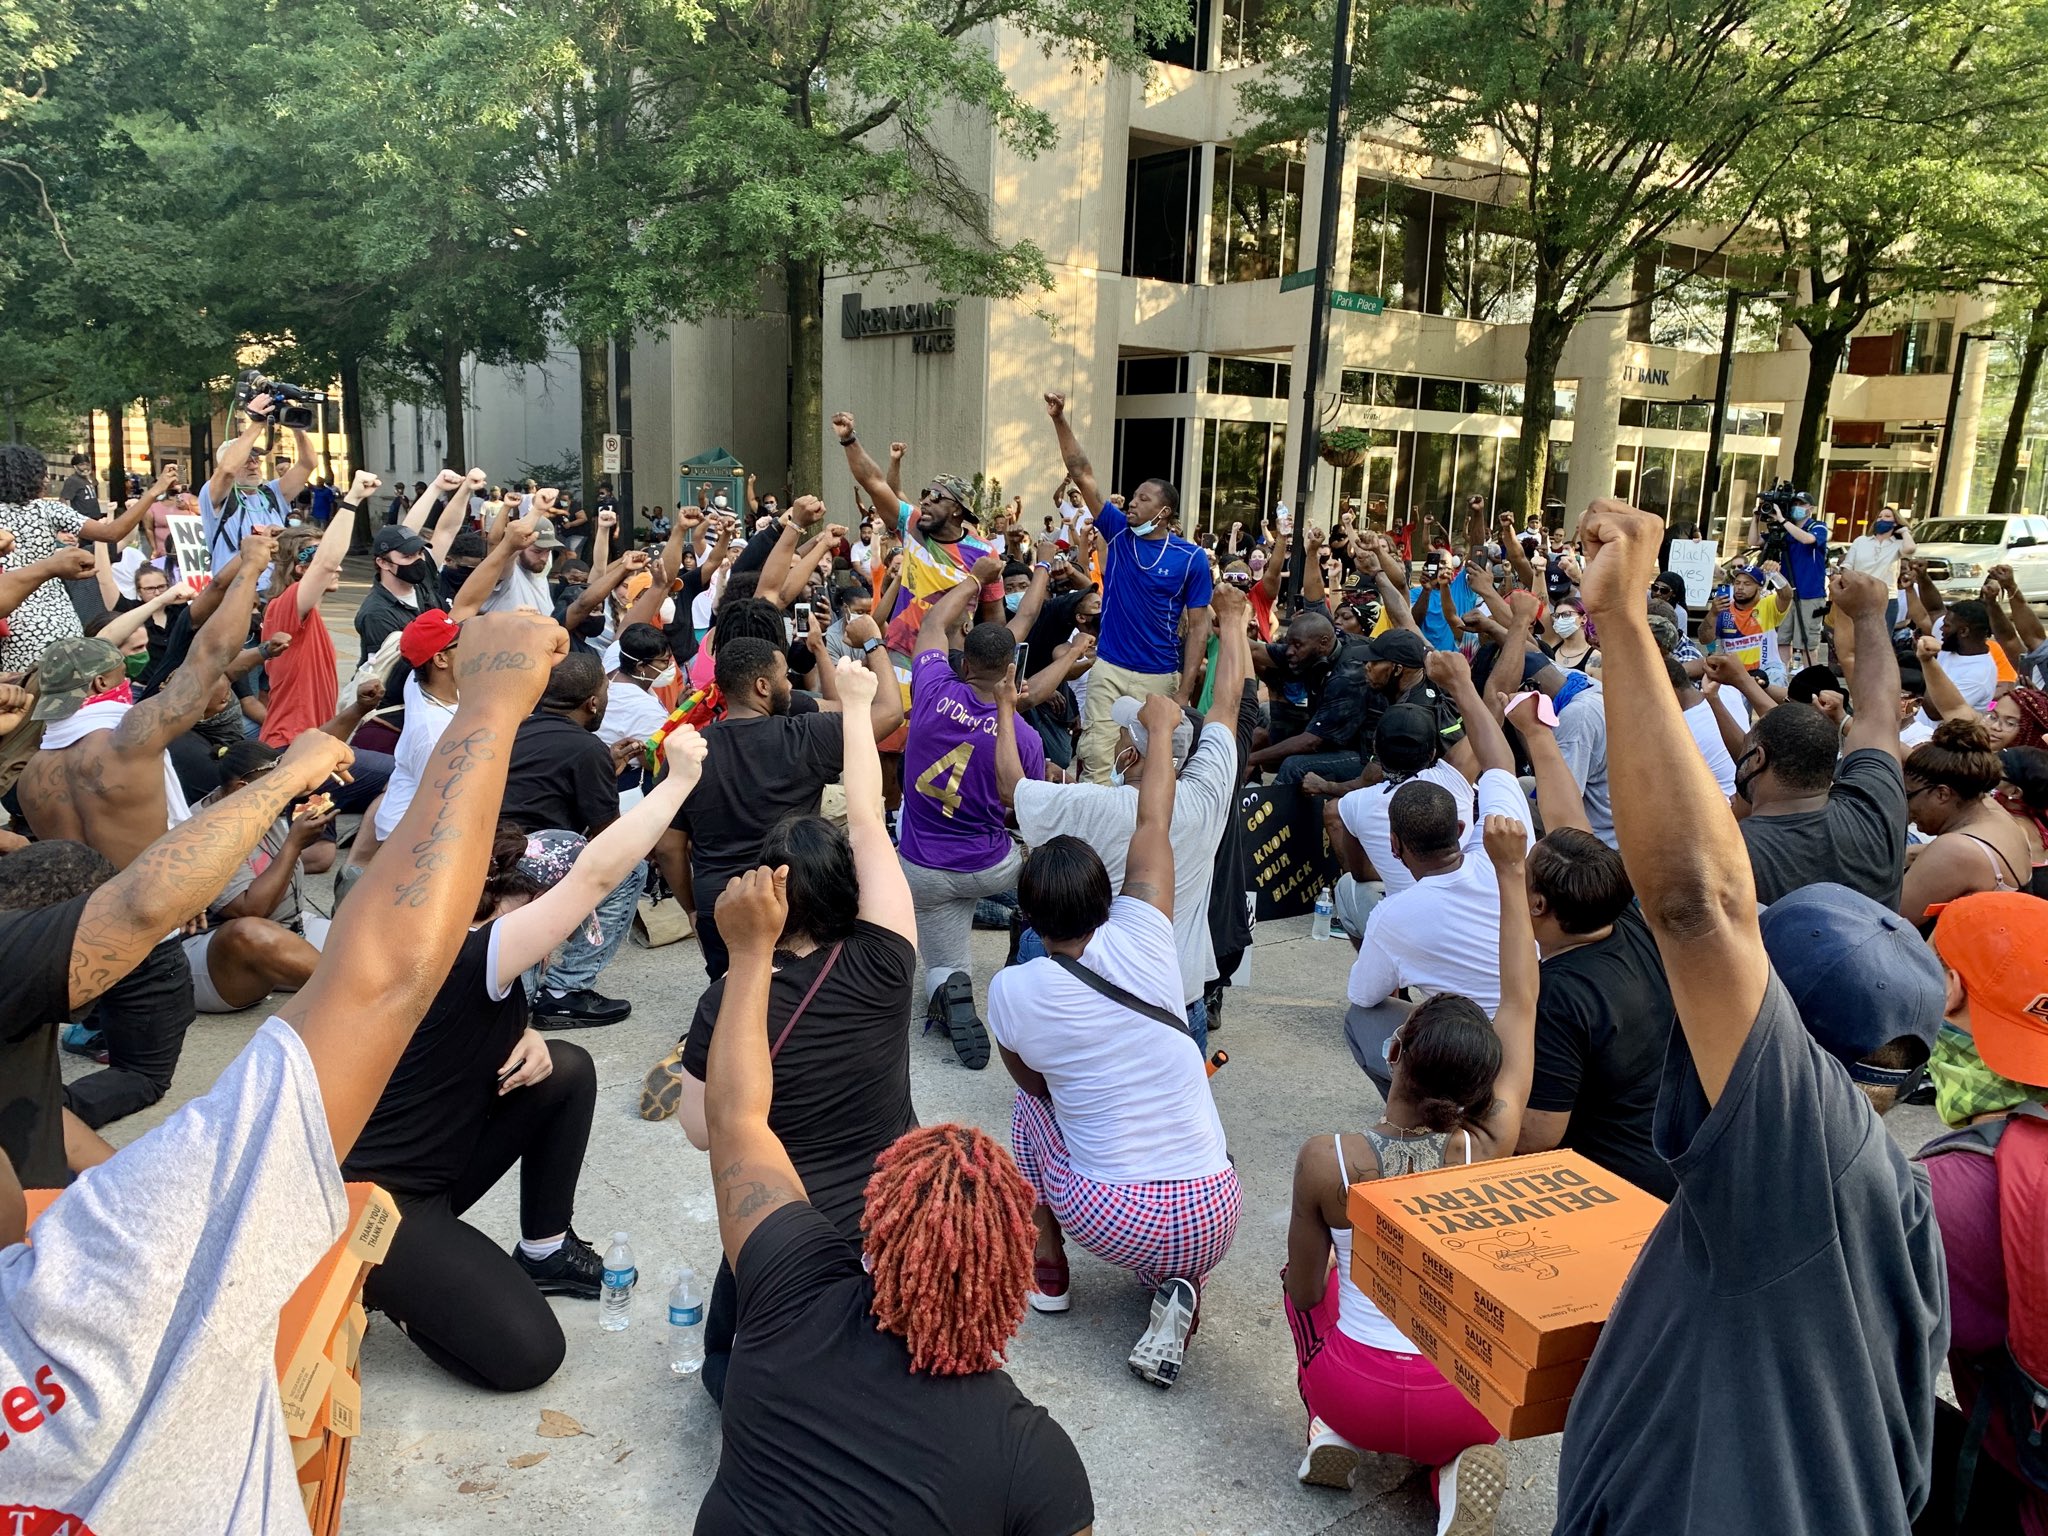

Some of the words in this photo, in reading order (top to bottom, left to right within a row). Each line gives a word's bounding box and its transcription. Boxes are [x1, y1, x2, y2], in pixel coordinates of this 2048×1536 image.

[1336, 294, 1353, 307] Park
[1357, 298, 1377, 311] Place
[912, 334, 955, 353] PLACE
[1638, 367, 1670, 386] BANK
[1672, 541, 1711, 564] Black
[951, 703, 982, 733] Dirty
[915, 741, 975, 819] 4
[1247, 800, 1274, 832] GOD
[1252, 825, 1292, 865] KNOW
[1255, 852, 1291, 888] YOUR
[1271, 860, 1313, 903] BLACK
[1393, 1168, 1590, 1215] DELIVERY!
[359, 1220, 375, 1243] THANK
[370, 1204, 382, 1221] YOU!
[1419, 1186, 1620, 1235] DELIVERY!
[367, 1225, 383, 1248] THANK
[377, 1208, 390, 1226] YOU!
[1376, 1214, 1404, 1245] DOUGH
[1422, 1251, 1454, 1283] CHEESE
[1419, 1284, 1448, 1316] CHEESE
[1474, 1290, 1505, 1322] SAUCE
[1411, 1317, 1438, 1349] CHEESE
[1465, 1324, 1493, 1356] SAUCE
[1454, 1358, 1480, 1391] SAUCE
